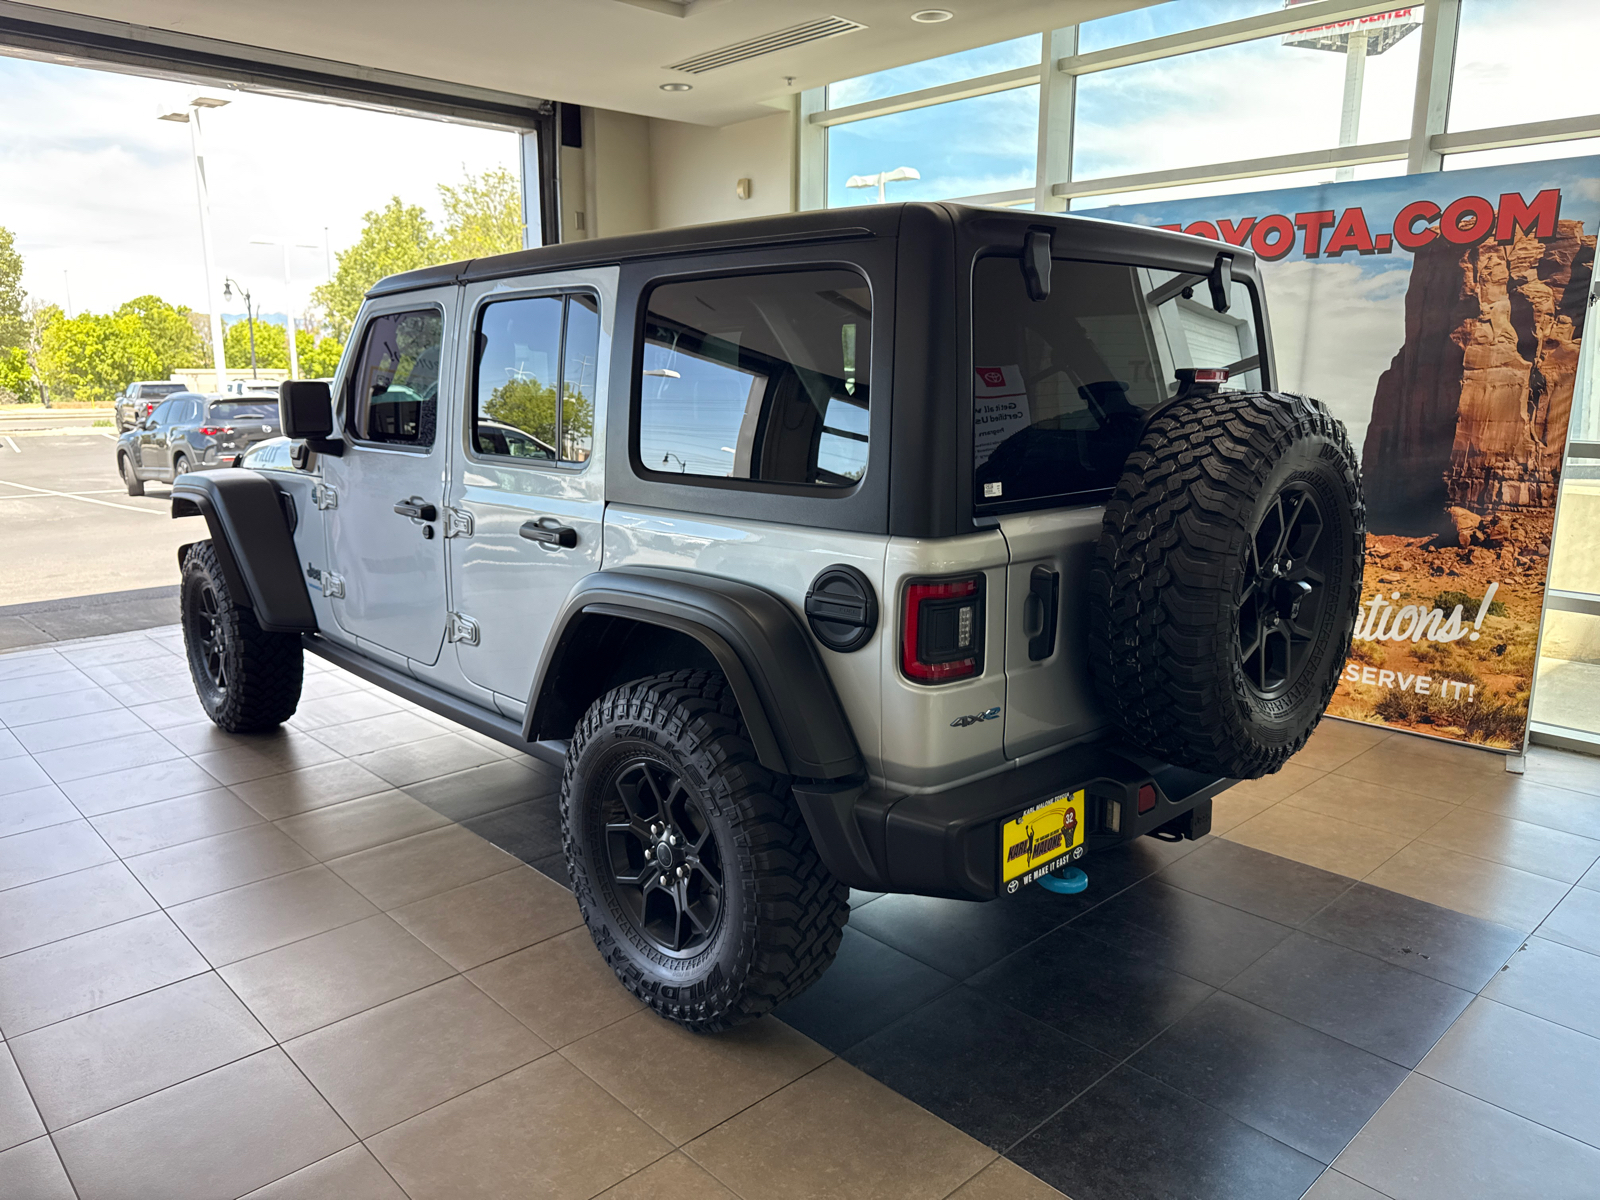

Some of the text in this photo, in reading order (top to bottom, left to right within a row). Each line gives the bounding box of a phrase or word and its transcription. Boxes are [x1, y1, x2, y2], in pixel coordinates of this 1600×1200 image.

[1157, 188, 1561, 259] YOTA.COM
[1339, 663, 1476, 703] SERVE IT!
[1023, 806, 1036, 817] KARL
[1036, 798, 1054, 812] MALONE
[1065, 812, 1074, 825] 32
[1007, 838, 1029, 863] KARL
[1032, 832, 1063, 860] MALONE
[1023, 854, 1070, 885] WE MAKE IT EASY
